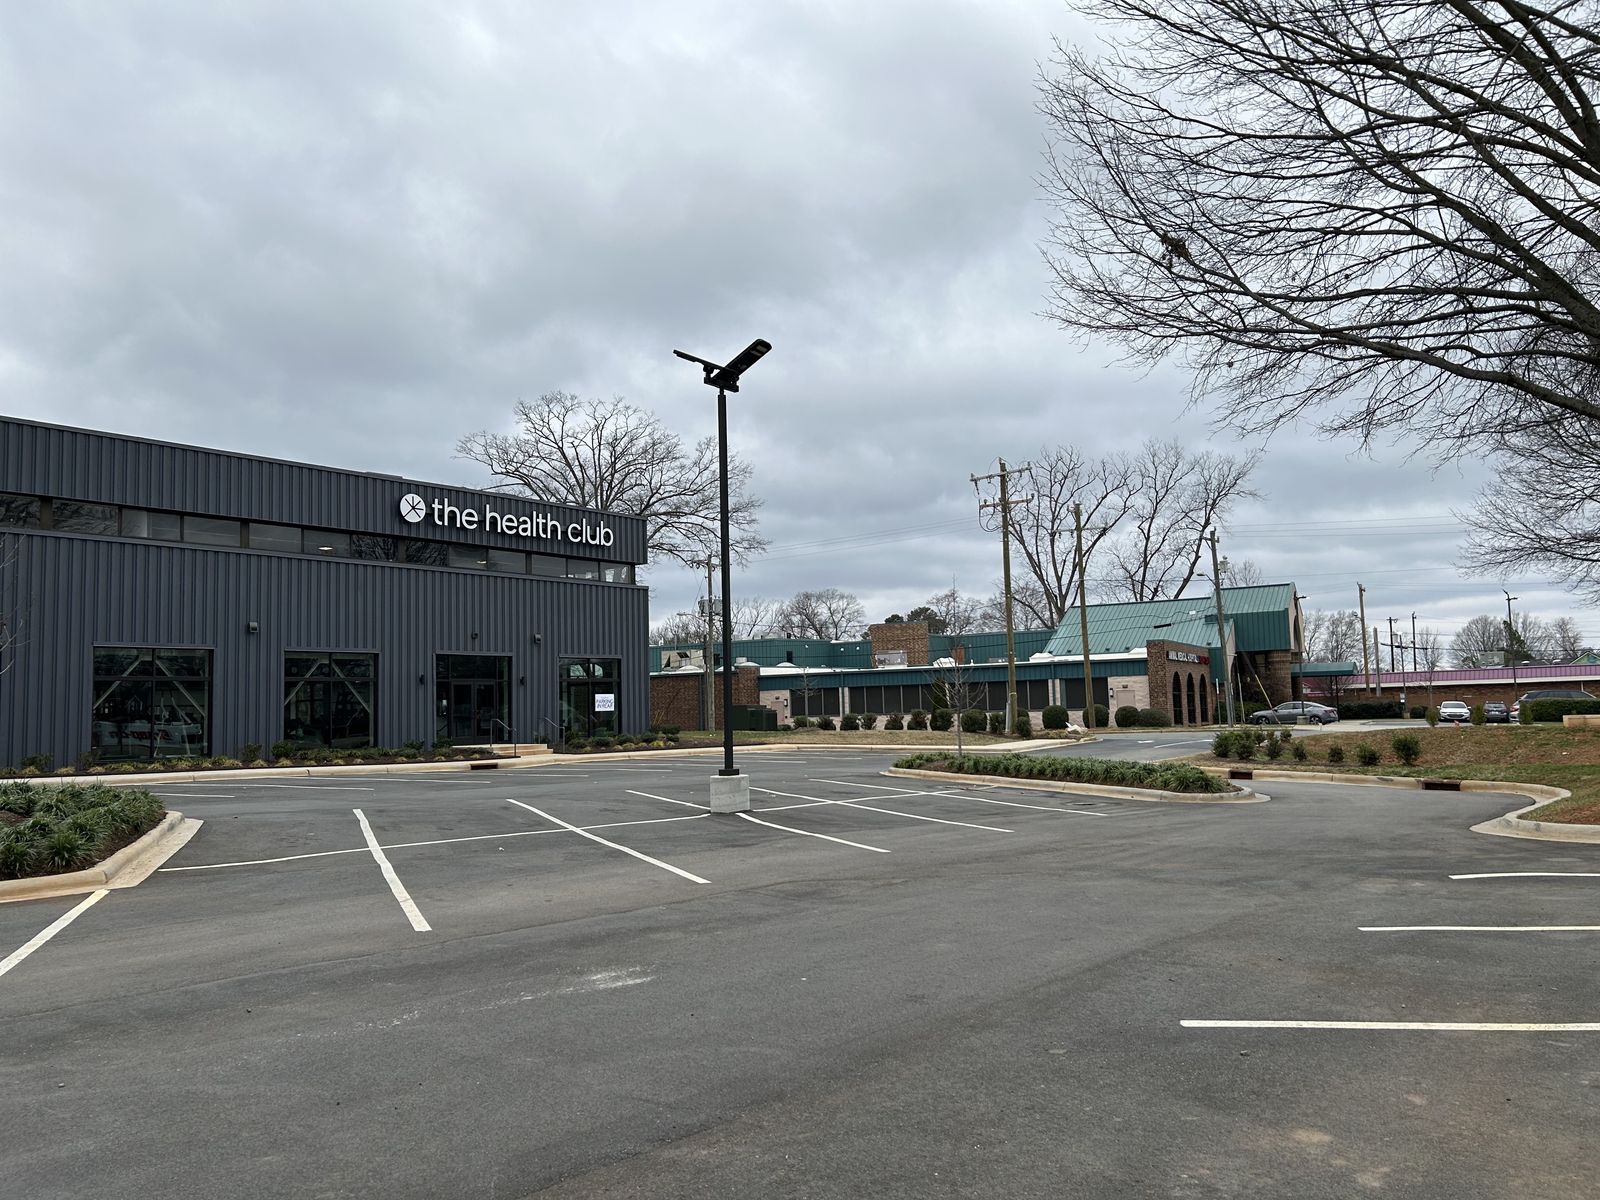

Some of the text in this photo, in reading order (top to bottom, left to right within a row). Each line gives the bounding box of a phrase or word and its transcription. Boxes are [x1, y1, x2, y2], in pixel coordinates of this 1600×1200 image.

[430, 497, 614, 547] the health club
